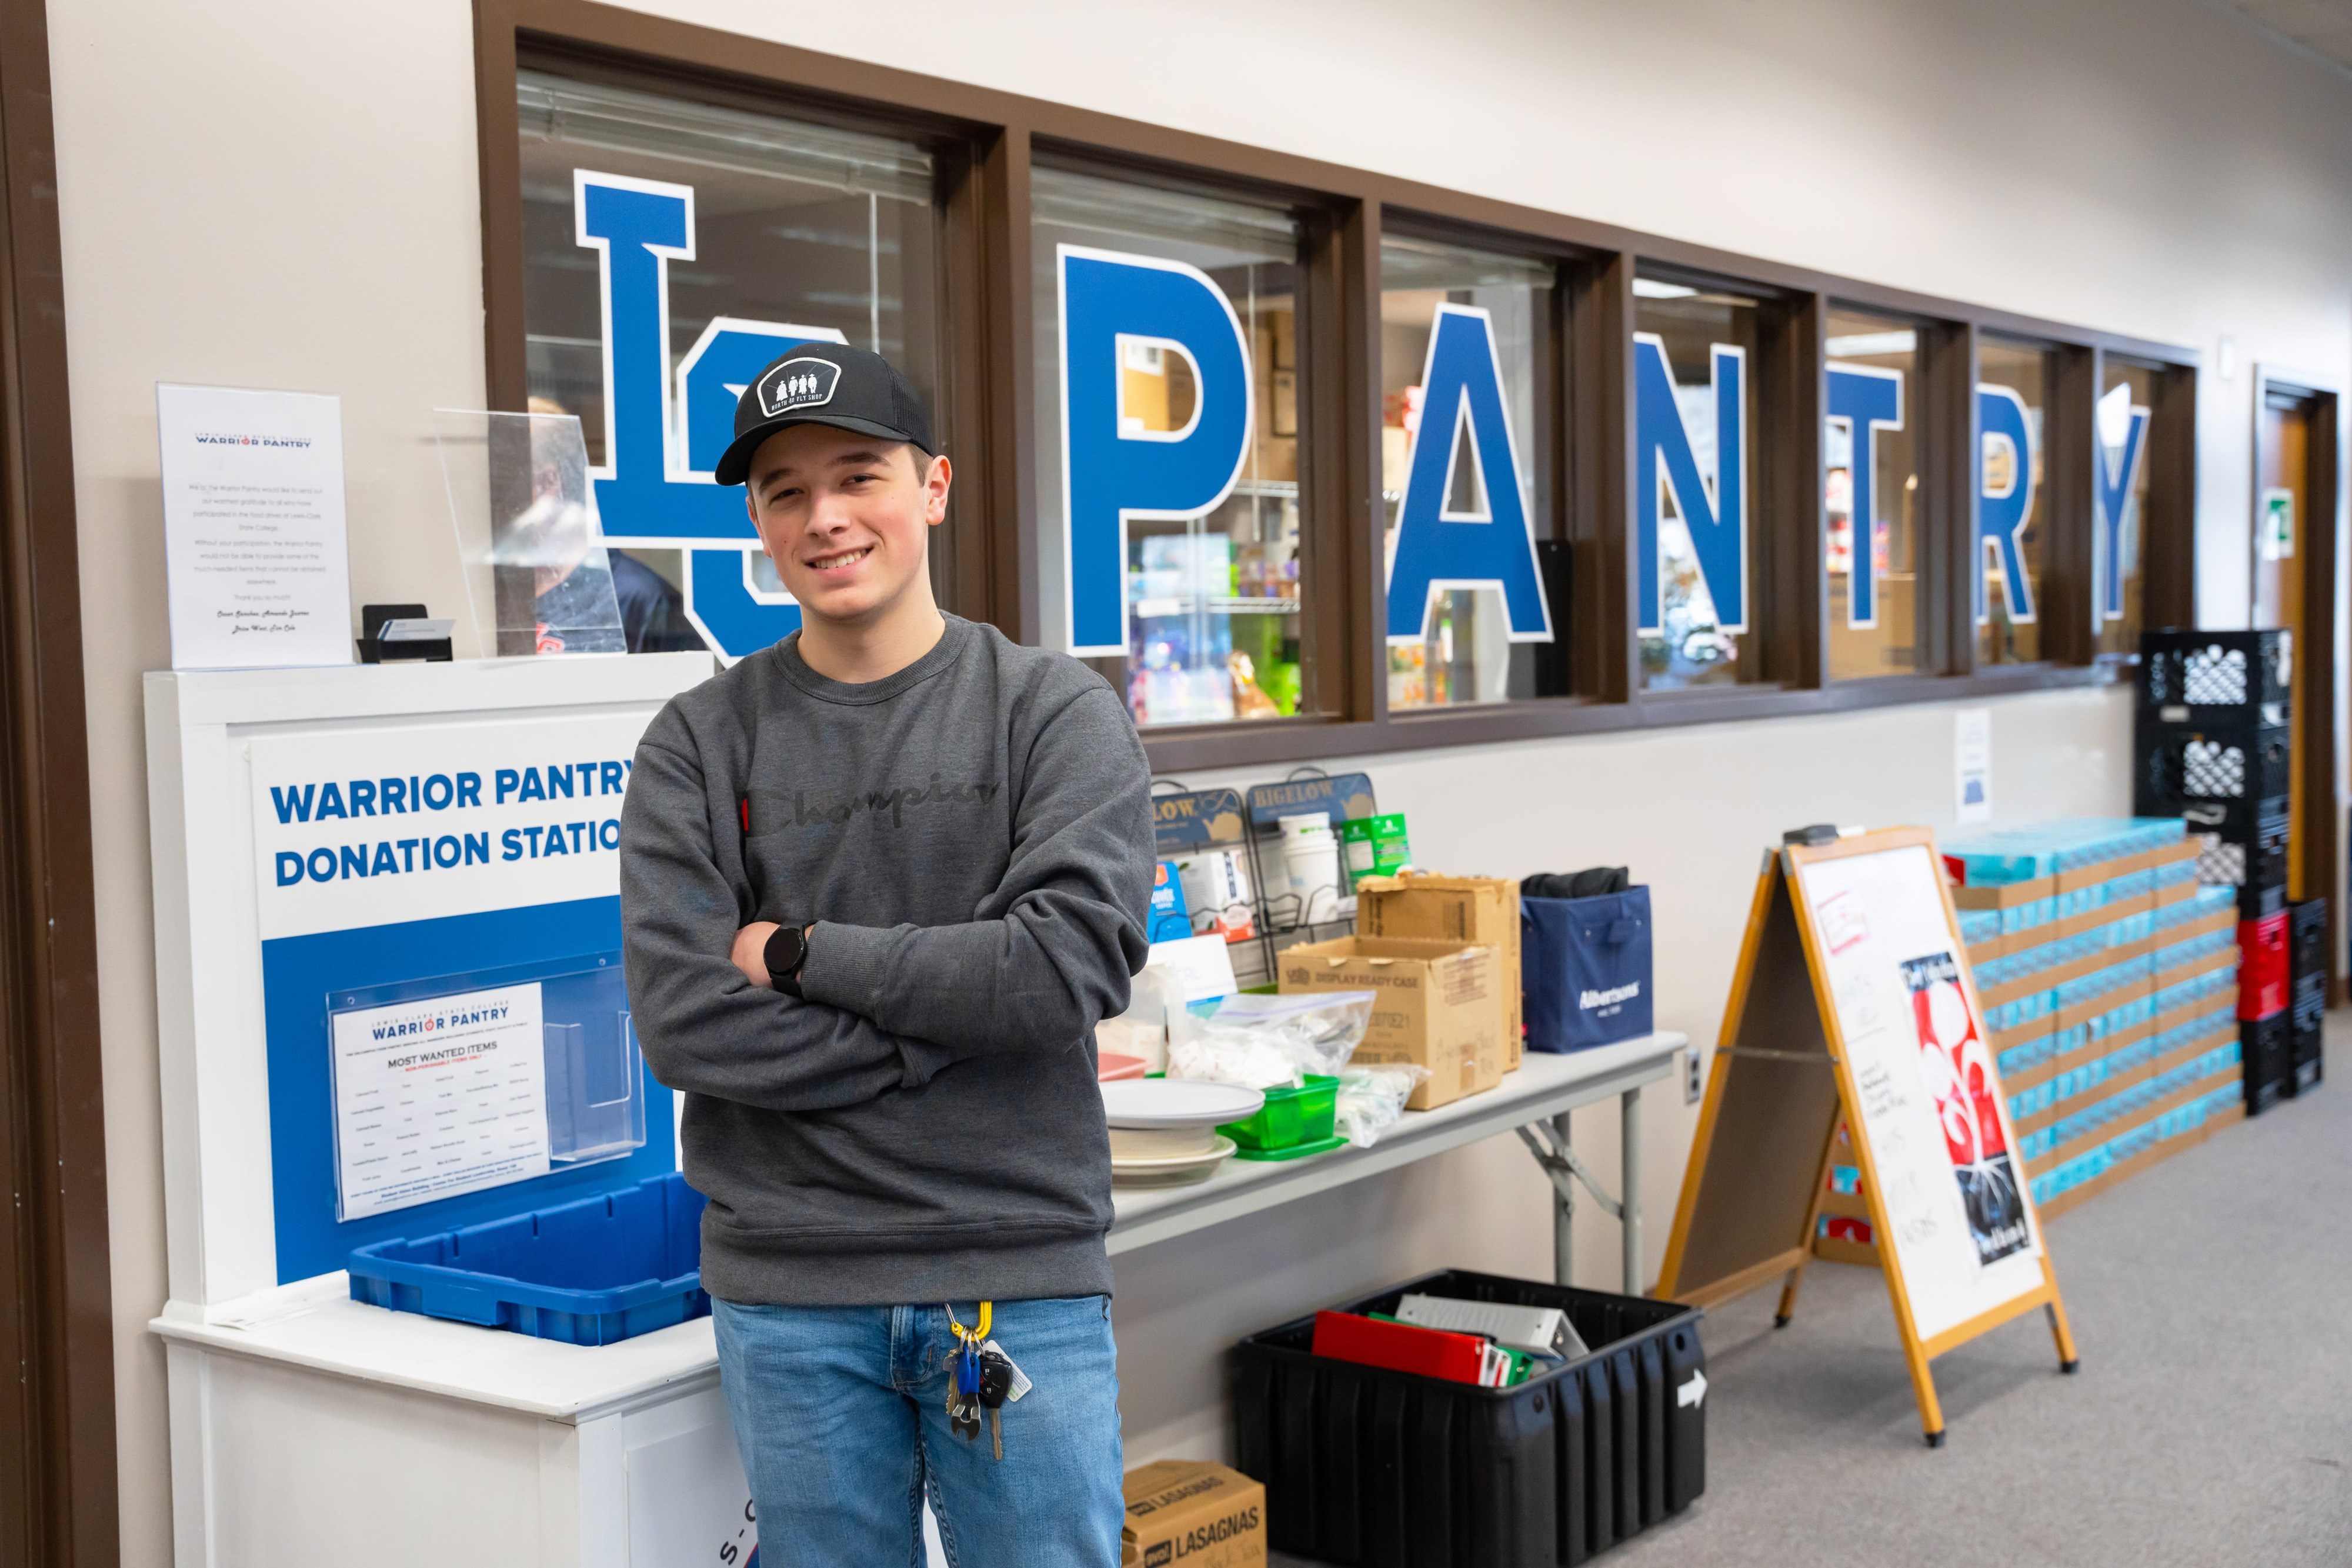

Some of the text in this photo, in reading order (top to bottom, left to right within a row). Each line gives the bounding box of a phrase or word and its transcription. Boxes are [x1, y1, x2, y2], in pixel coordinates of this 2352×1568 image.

[772, 401, 787, 411] NORTH
[196, 437, 258, 446] WARRIOR
[270, 760, 633, 825] WARRIOR PANTR
[1254, 781, 1334, 808] BIGELOW
[275, 818, 620, 888] DONATION STATIO
[1316, 972, 1356, 985] DISPLAY
[1359, 974, 1390, 987] READY
[1392, 976, 1418, 989] CASE
[373, 1017, 445, 1040] WARRIOR
[451, 1006, 509, 1027] PANTRY
[388, 1055, 418, 1069] MOST
[420, 1047, 465, 1062] WANTED
[468, 1040, 498, 1054] ITEMS
[1151, 1476, 1224, 1508] LASAGNAS
[1176, 1505, 1259, 1559] LASAGNAS
